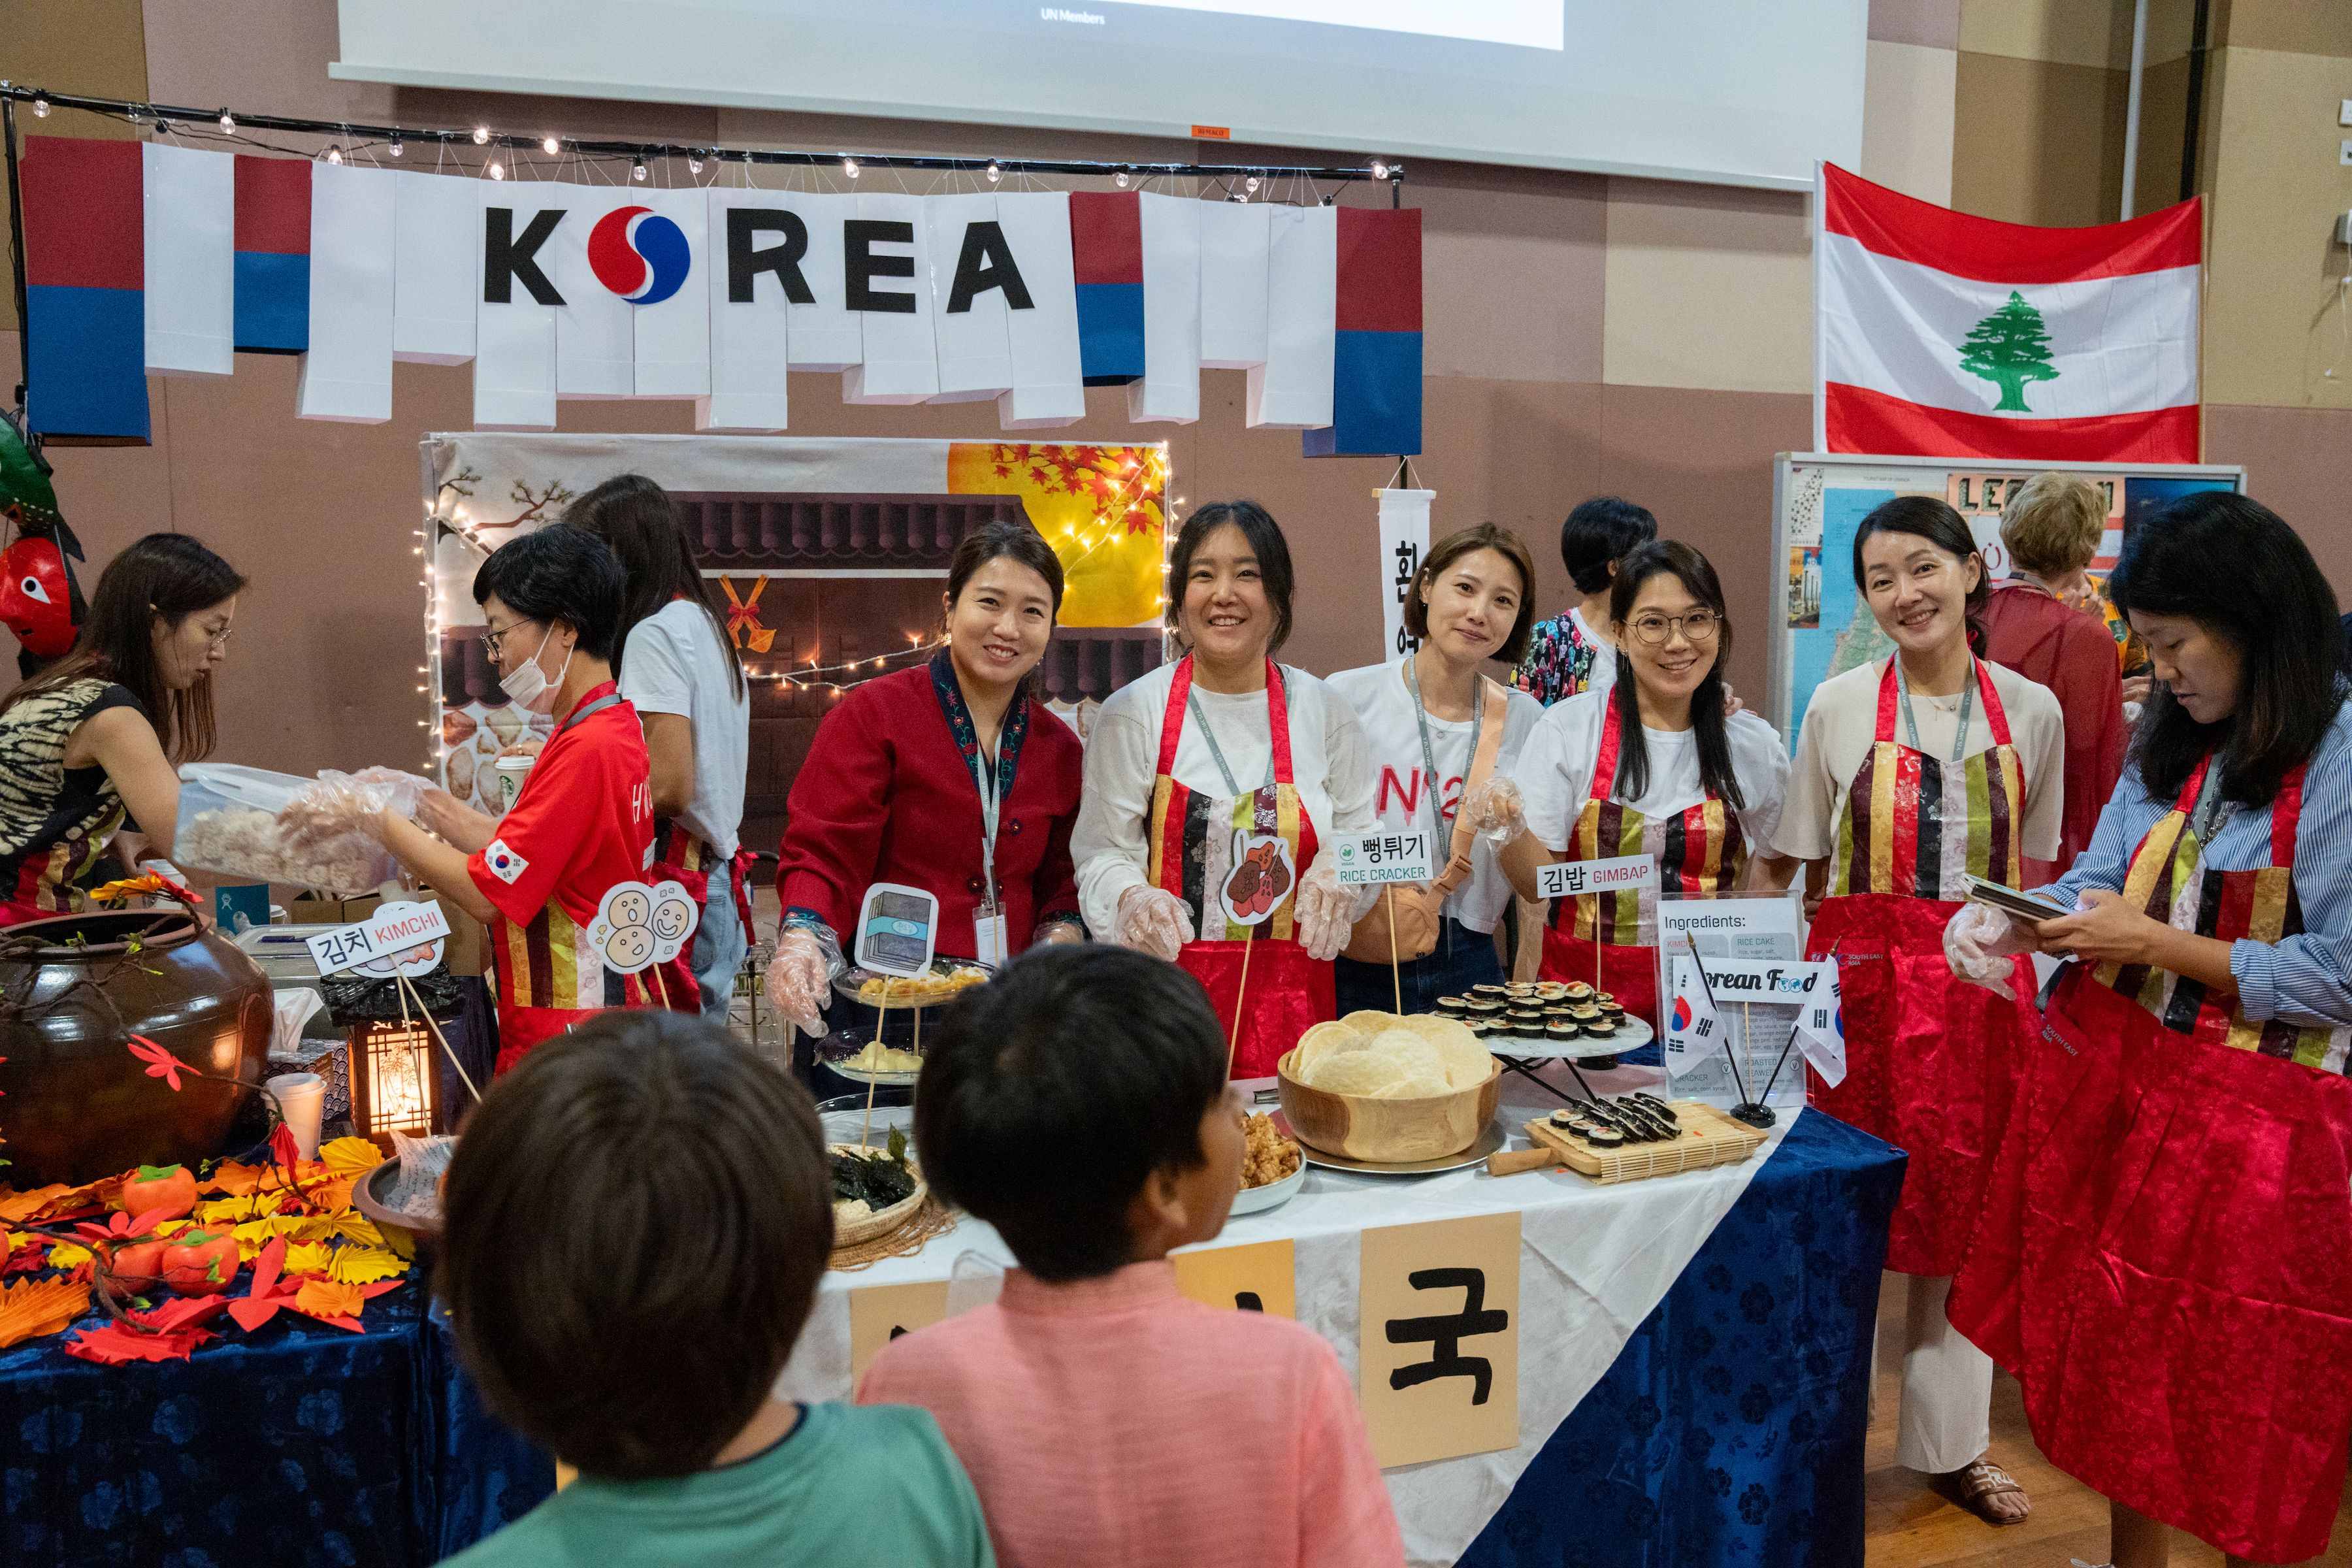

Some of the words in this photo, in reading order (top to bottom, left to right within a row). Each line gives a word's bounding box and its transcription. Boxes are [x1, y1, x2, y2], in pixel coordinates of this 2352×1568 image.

[1041, 8, 1058, 20] UN
[1059, 9, 1105, 25] Members
[1362, 834, 1424, 864] 뻥튀기
[1341, 870, 1367, 882] RICE
[1370, 867, 1426, 881] CRACKER
[1544, 866, 1587, 893] 김밥
[1593, 866, 1648, 883] GIMBAP
[375, 911, 440, 944] KIMCHI
[1665, 915, 1746, 931] Ingredients:
[318, 928, 372, 966] 김치
[1706, 972, 1762, 990] orean
